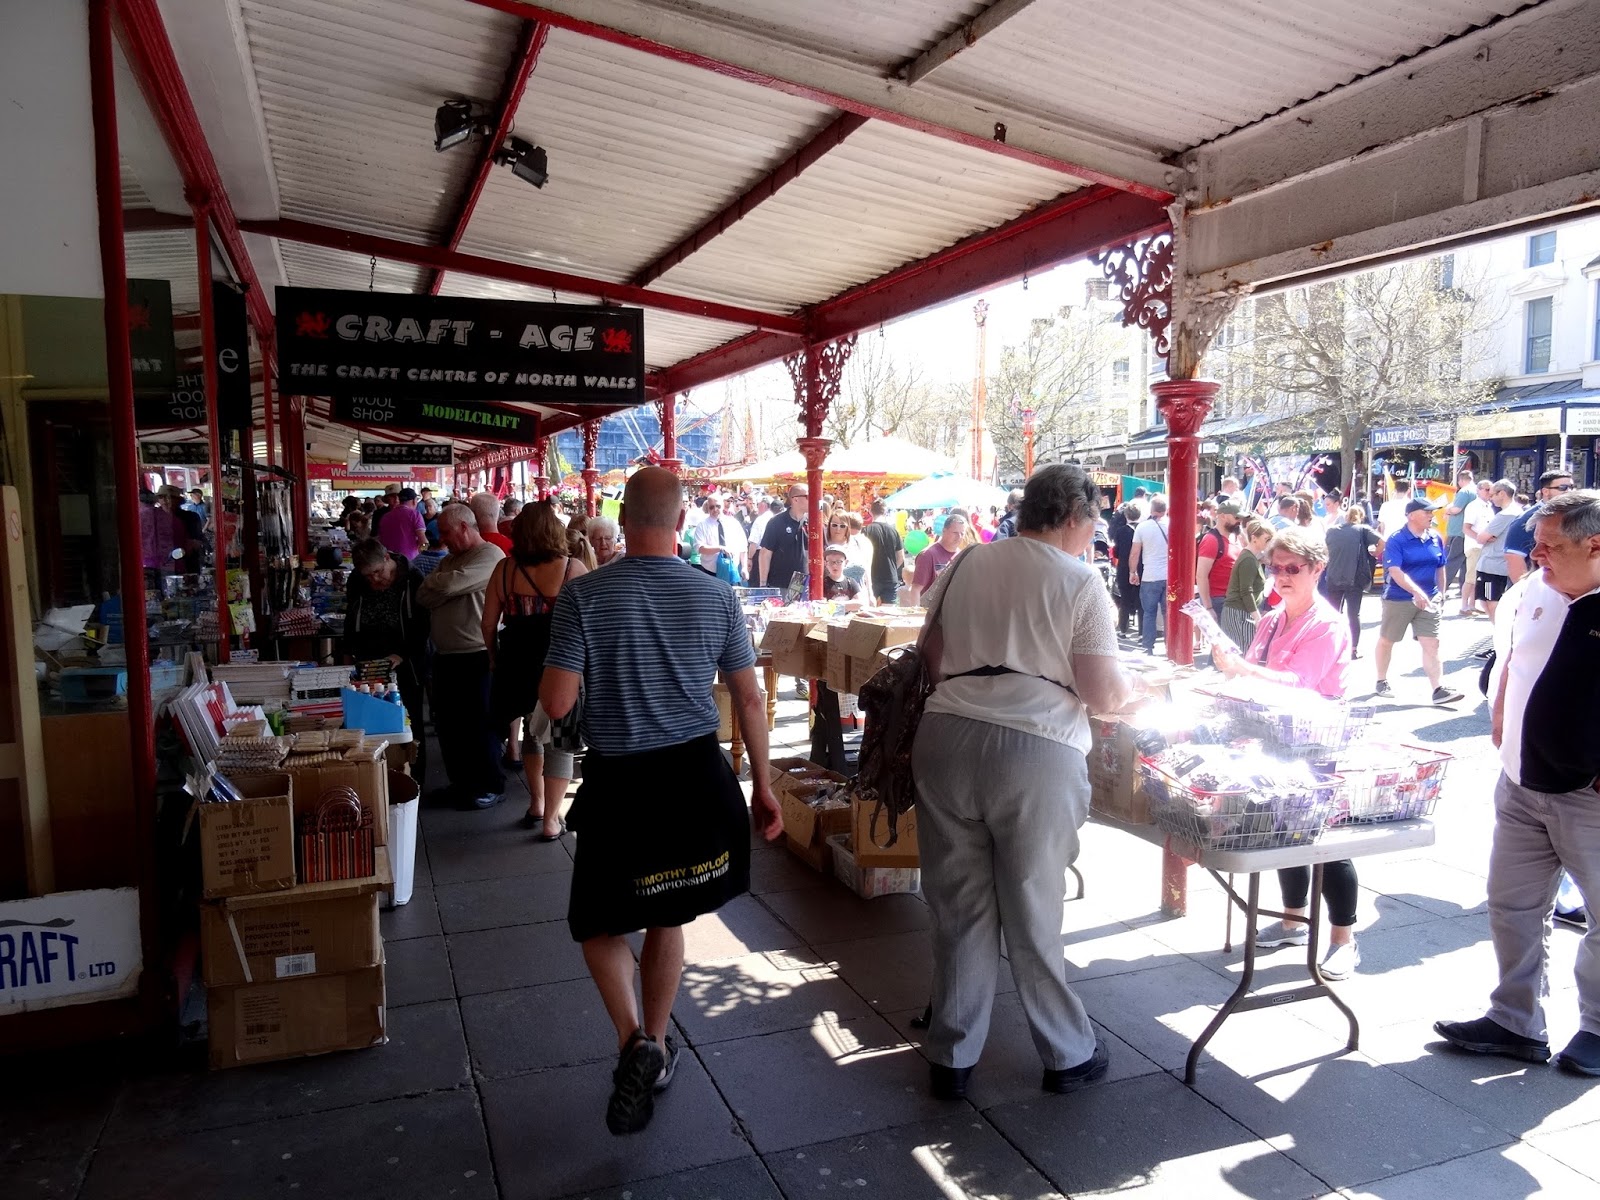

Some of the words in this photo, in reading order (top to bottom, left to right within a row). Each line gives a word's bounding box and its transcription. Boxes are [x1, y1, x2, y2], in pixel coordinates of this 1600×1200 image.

[335, 314, 475, 349] CRAFT
[518, 324, 597, 353] AGE
[219, 348, 241, 373] e
[290, 363, 330, 378] THE
[336, 365, 401, 381] CRAFT
[407, 368, 479, 385] CENTRE
[484, 371, 511, 385] OF
[515, 372, 578, 387] NORTH
[583, 375, 638, 391] WALES
[352, 405, 395, 423] SHOP
[421, 403, 521, 430] MODELCRAFT
[1374, 431, 1400, 444] DAILY
[366, 446, 409, 456] CRAFT
[421, 446, 448, 456] AGE
[1395, 469, 1407, 477] ON
[1341, 496, 1350, 511] 8
[633, 867, 687, 888] TIMOTHY
[635, 874, 712, 897] CHAMPIONSHIP
[89, 961, 116, 979] LTD
